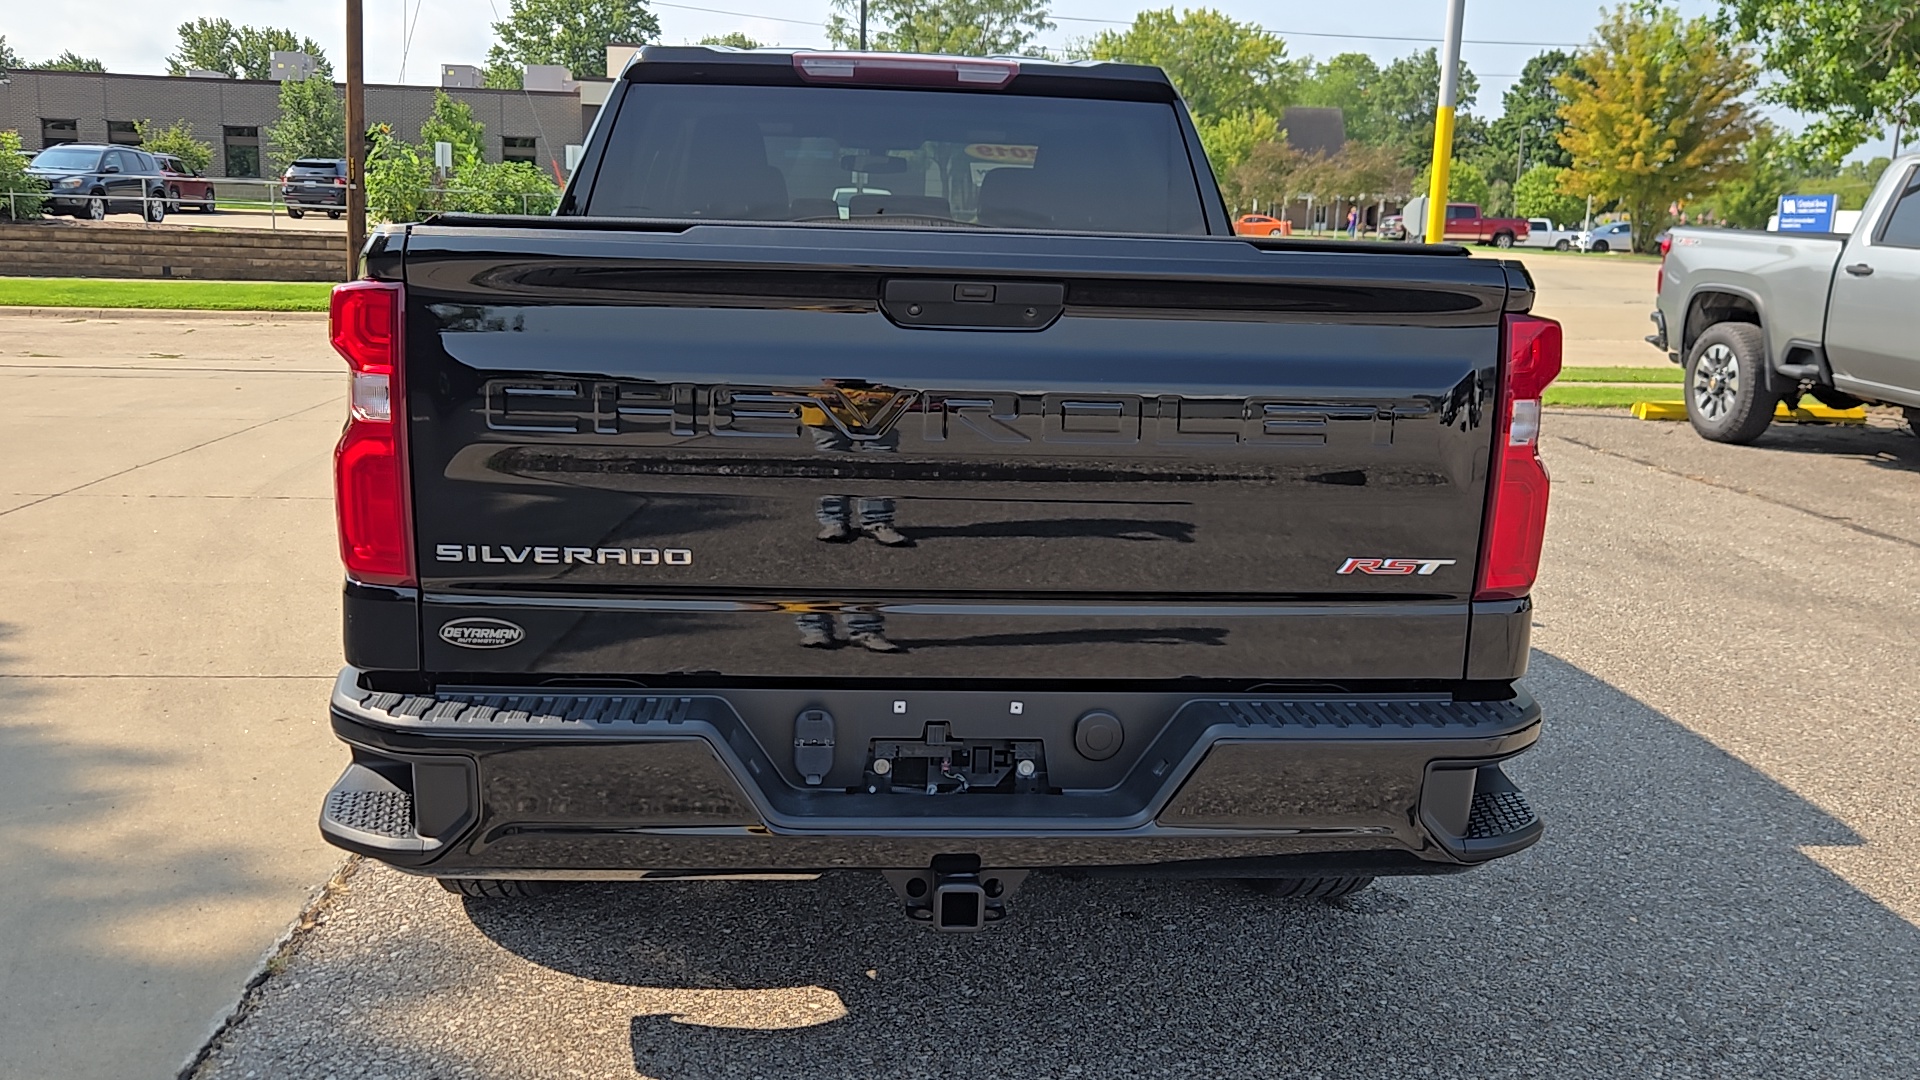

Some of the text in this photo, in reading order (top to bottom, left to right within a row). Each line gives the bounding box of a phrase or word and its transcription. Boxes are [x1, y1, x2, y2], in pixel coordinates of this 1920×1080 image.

[485, 379, 1430, 447] CHEVROLET
[436, 544, 693, 565] SILVERADO
[1336, 558, 1457, 575] RST
[444, 627, 520, 640] DEYARMAN
